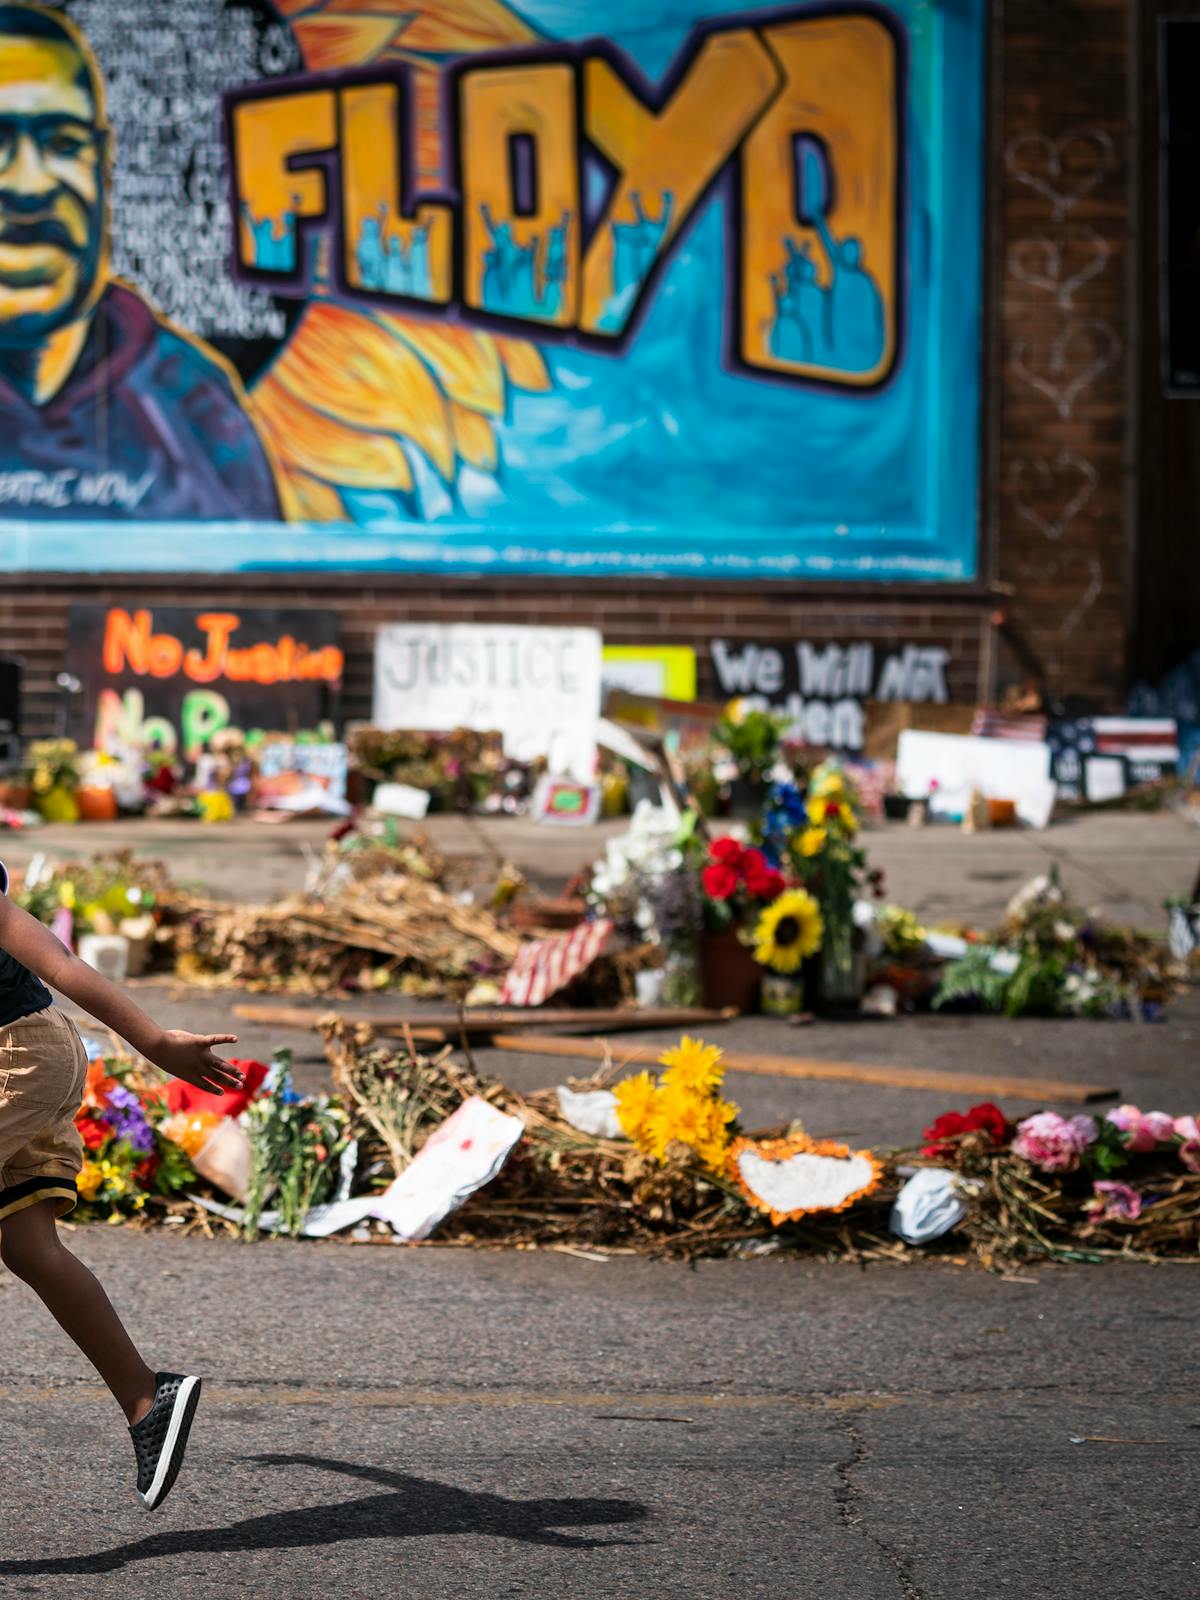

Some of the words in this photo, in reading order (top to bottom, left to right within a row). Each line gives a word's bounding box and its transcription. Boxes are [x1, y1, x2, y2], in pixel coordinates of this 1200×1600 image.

[228, 12, 902, 388] FLOYD
[103, 606, 183, 680] No
[384, 634, 581, 694] JUSTICE
[710, 639, 784, 694] We
[795, 640, 874, 697] Will
